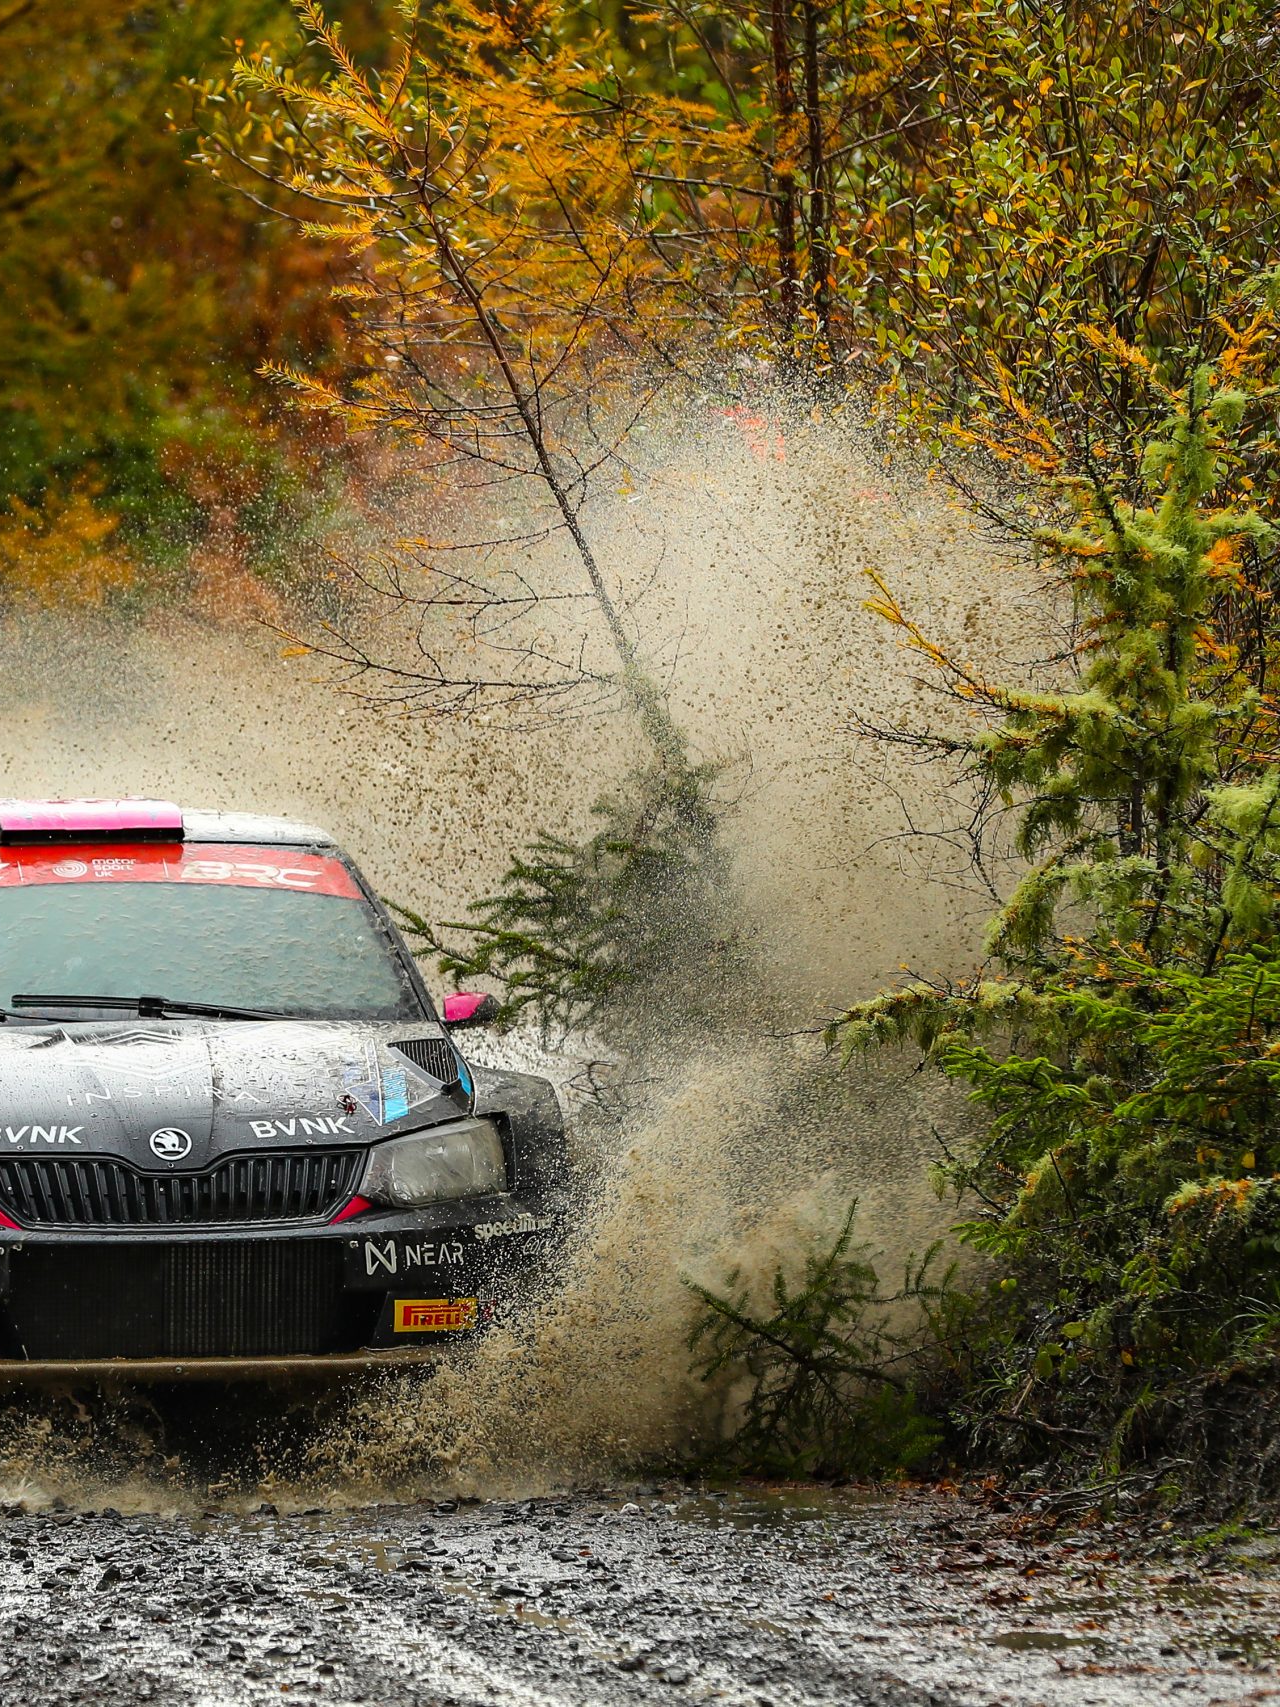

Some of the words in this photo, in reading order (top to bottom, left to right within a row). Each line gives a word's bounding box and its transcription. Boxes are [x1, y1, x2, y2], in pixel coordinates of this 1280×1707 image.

[181, 860, 323, 887] BRC
[66, 1085, 265, 1106] INSPIRA
[249, 1116, 355, 1139] BVNK
[405, 1242, 464, 1267] NEAR
